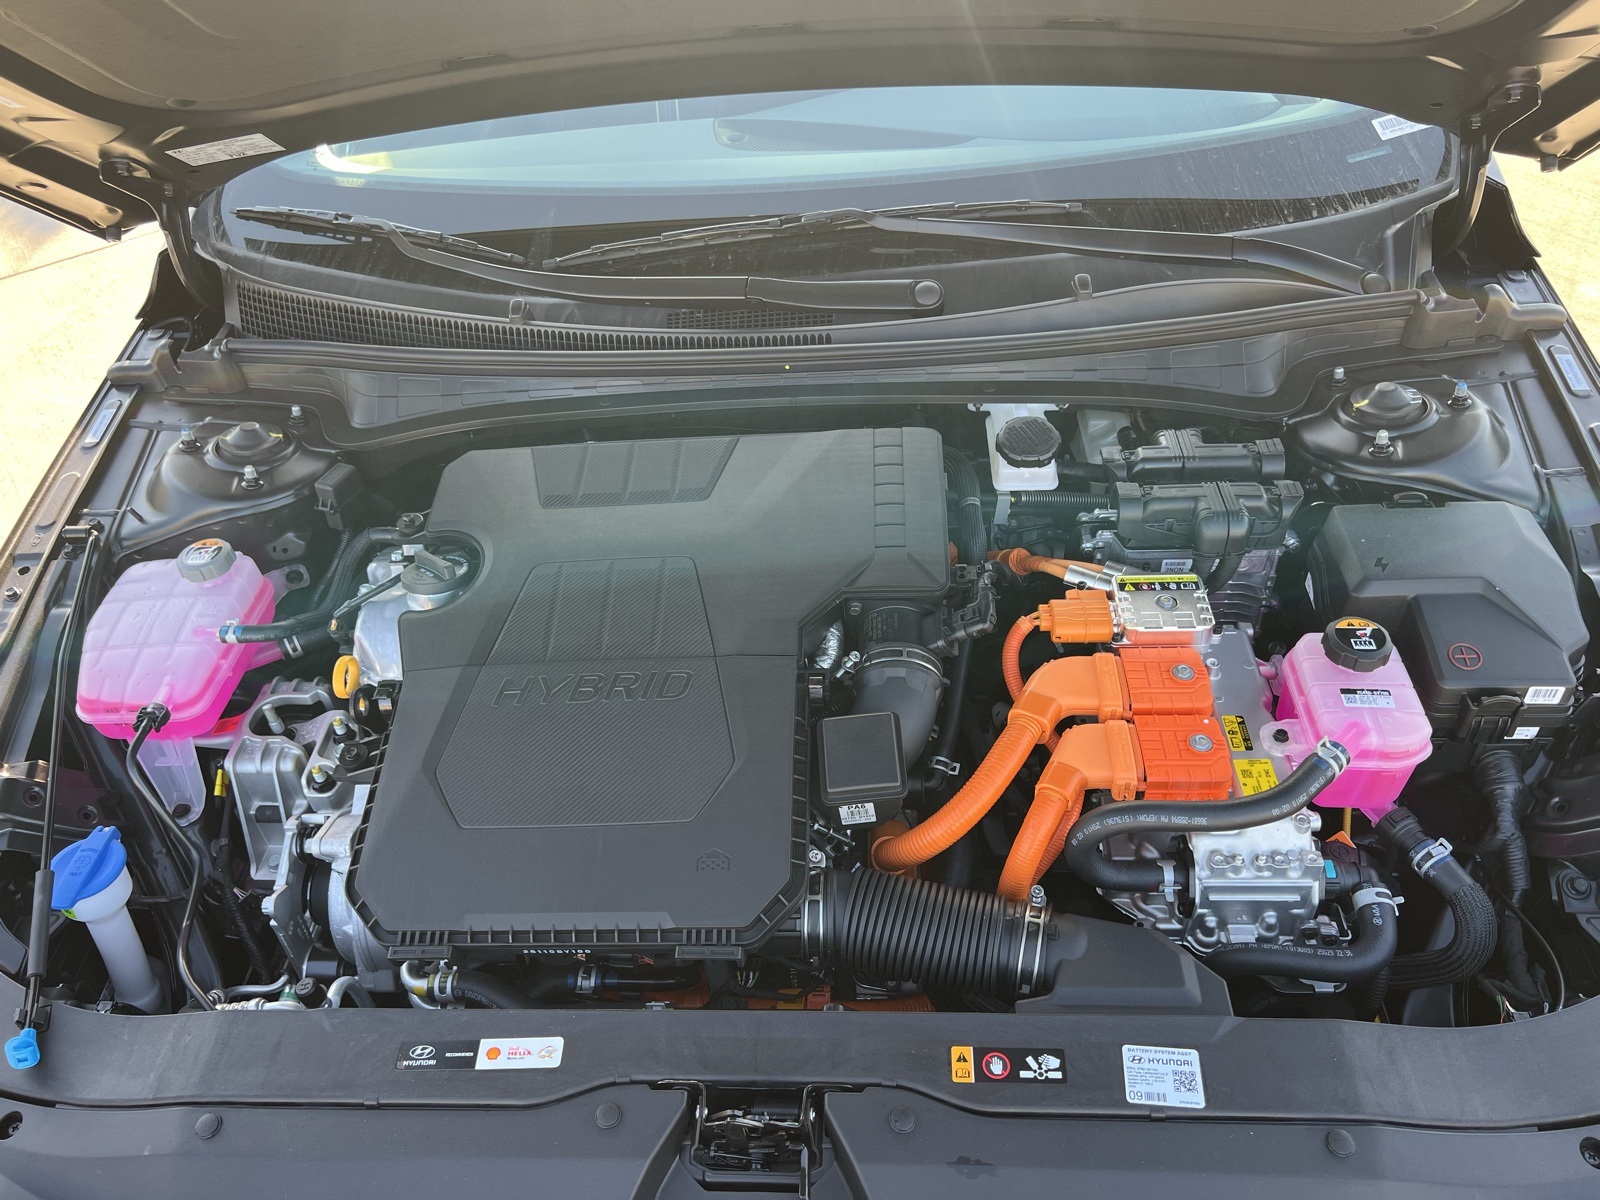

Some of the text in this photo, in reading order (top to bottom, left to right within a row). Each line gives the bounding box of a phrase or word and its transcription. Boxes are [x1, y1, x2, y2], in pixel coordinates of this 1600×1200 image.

[491, 669, 695, 708] HYBRID
[1127, 1047, 1153, 1055] BATTERY
[402, 1059, 437, 1067] HYUNDAI
[1148, 1057, 1193, 1067] HYUNDAI
[1128, 1090, 1143, 1101] 09
